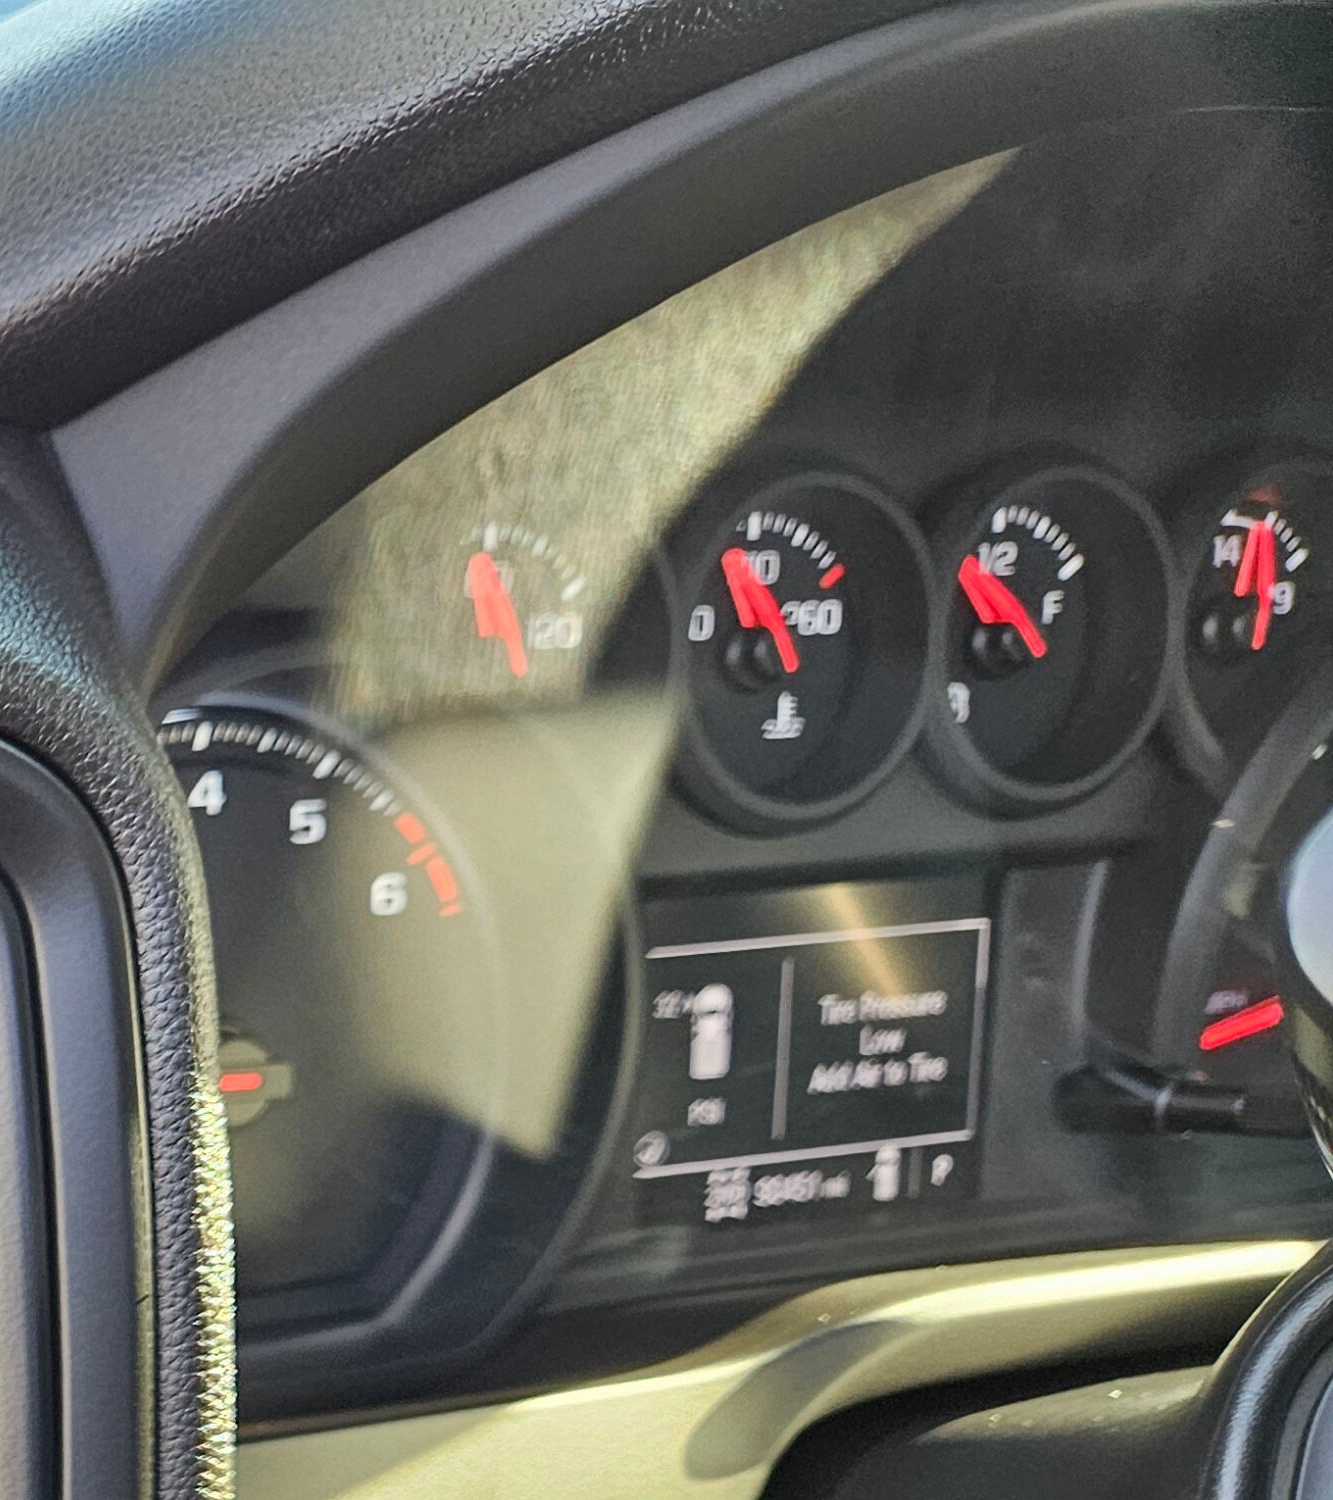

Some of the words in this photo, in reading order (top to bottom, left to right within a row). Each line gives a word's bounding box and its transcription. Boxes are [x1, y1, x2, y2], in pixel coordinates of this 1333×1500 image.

[1212, 534, 1243, 569] 14
[1041, 589, 1066, 625] F
[187, 769, 227, 816] 4
[289, 798, 328, 845] 5
[370, 872, 408, 917] 6
